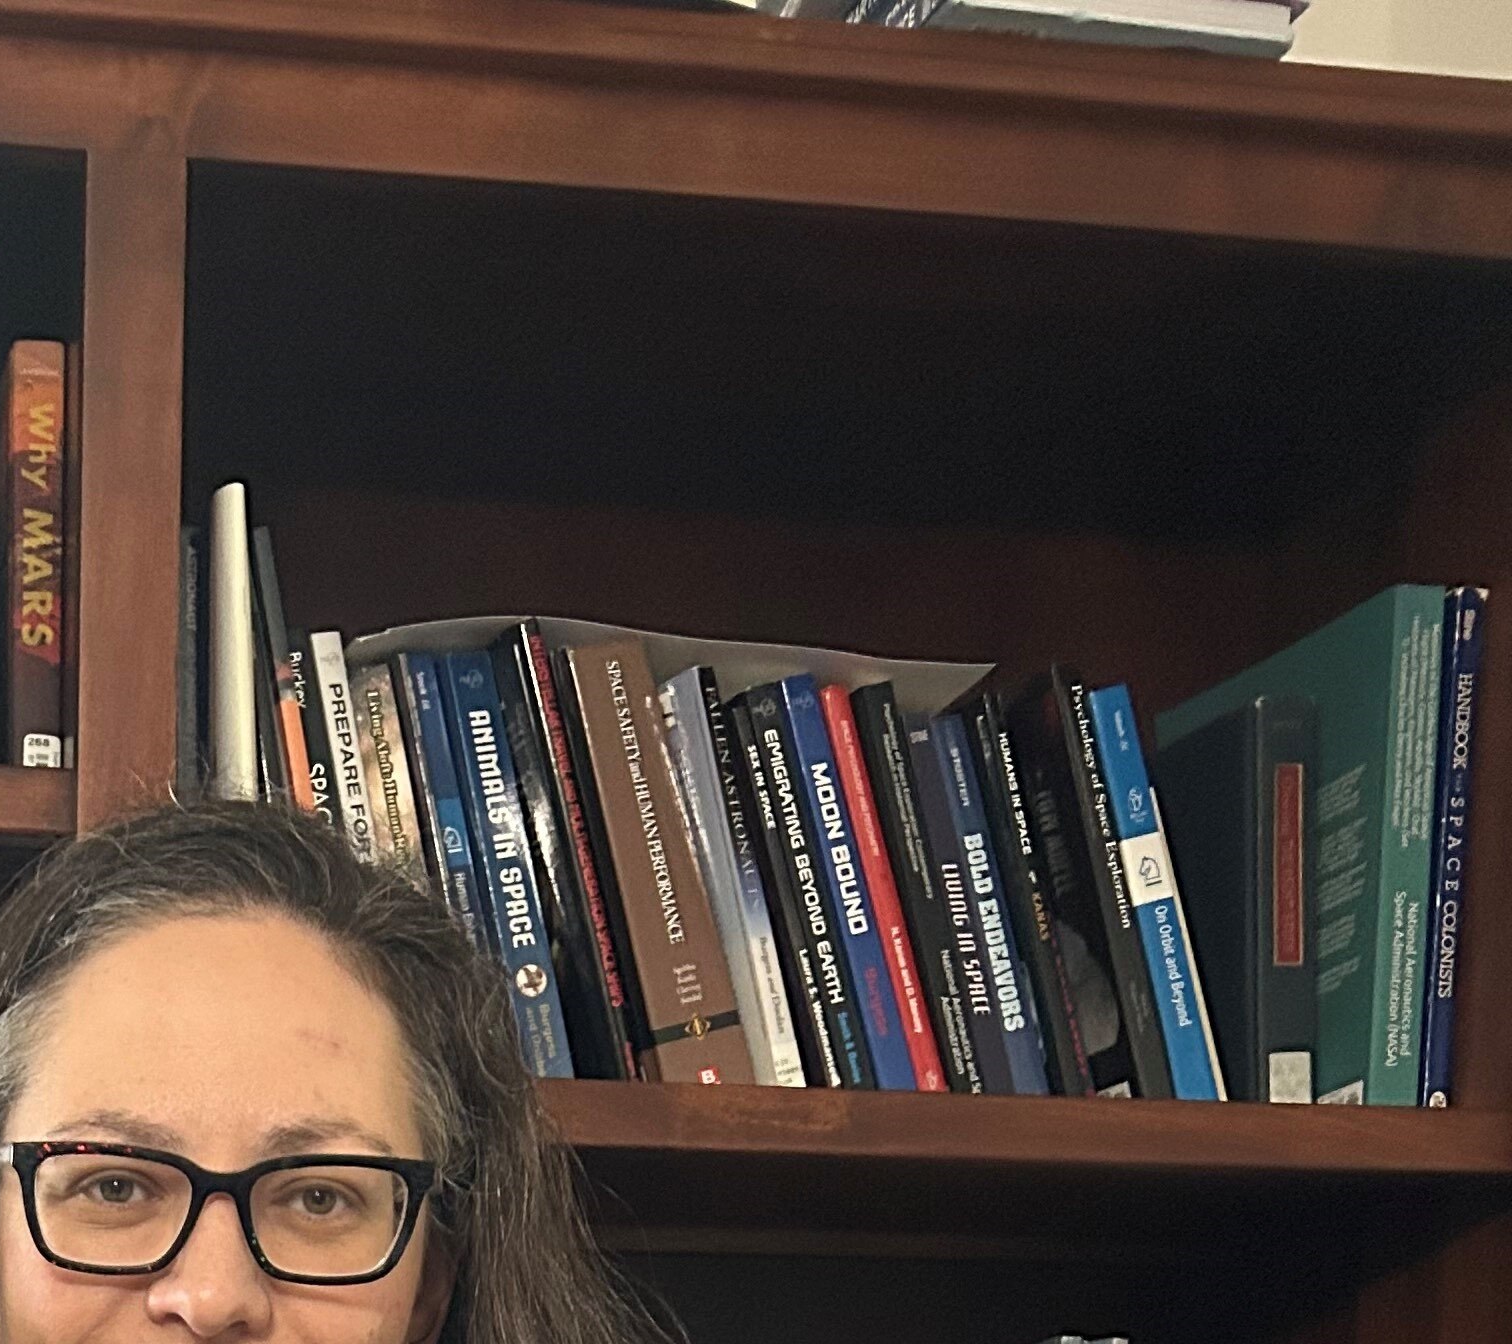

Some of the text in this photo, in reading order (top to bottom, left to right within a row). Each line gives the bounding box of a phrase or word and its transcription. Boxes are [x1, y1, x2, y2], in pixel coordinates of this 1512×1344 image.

[468, 708, 535, 948] ANIMALS IN SPACE
[763, 727, 843, 1004] EMIGRATING BEYOND EARTH
[810, 760, 846, 840] MOON
[829, 843, 868, 935] BOUND
[1069, 683, 1132, 930] Psychology of Space Exploration
[963, 831, 1025, 1032] BOLD ENDEAVORS
